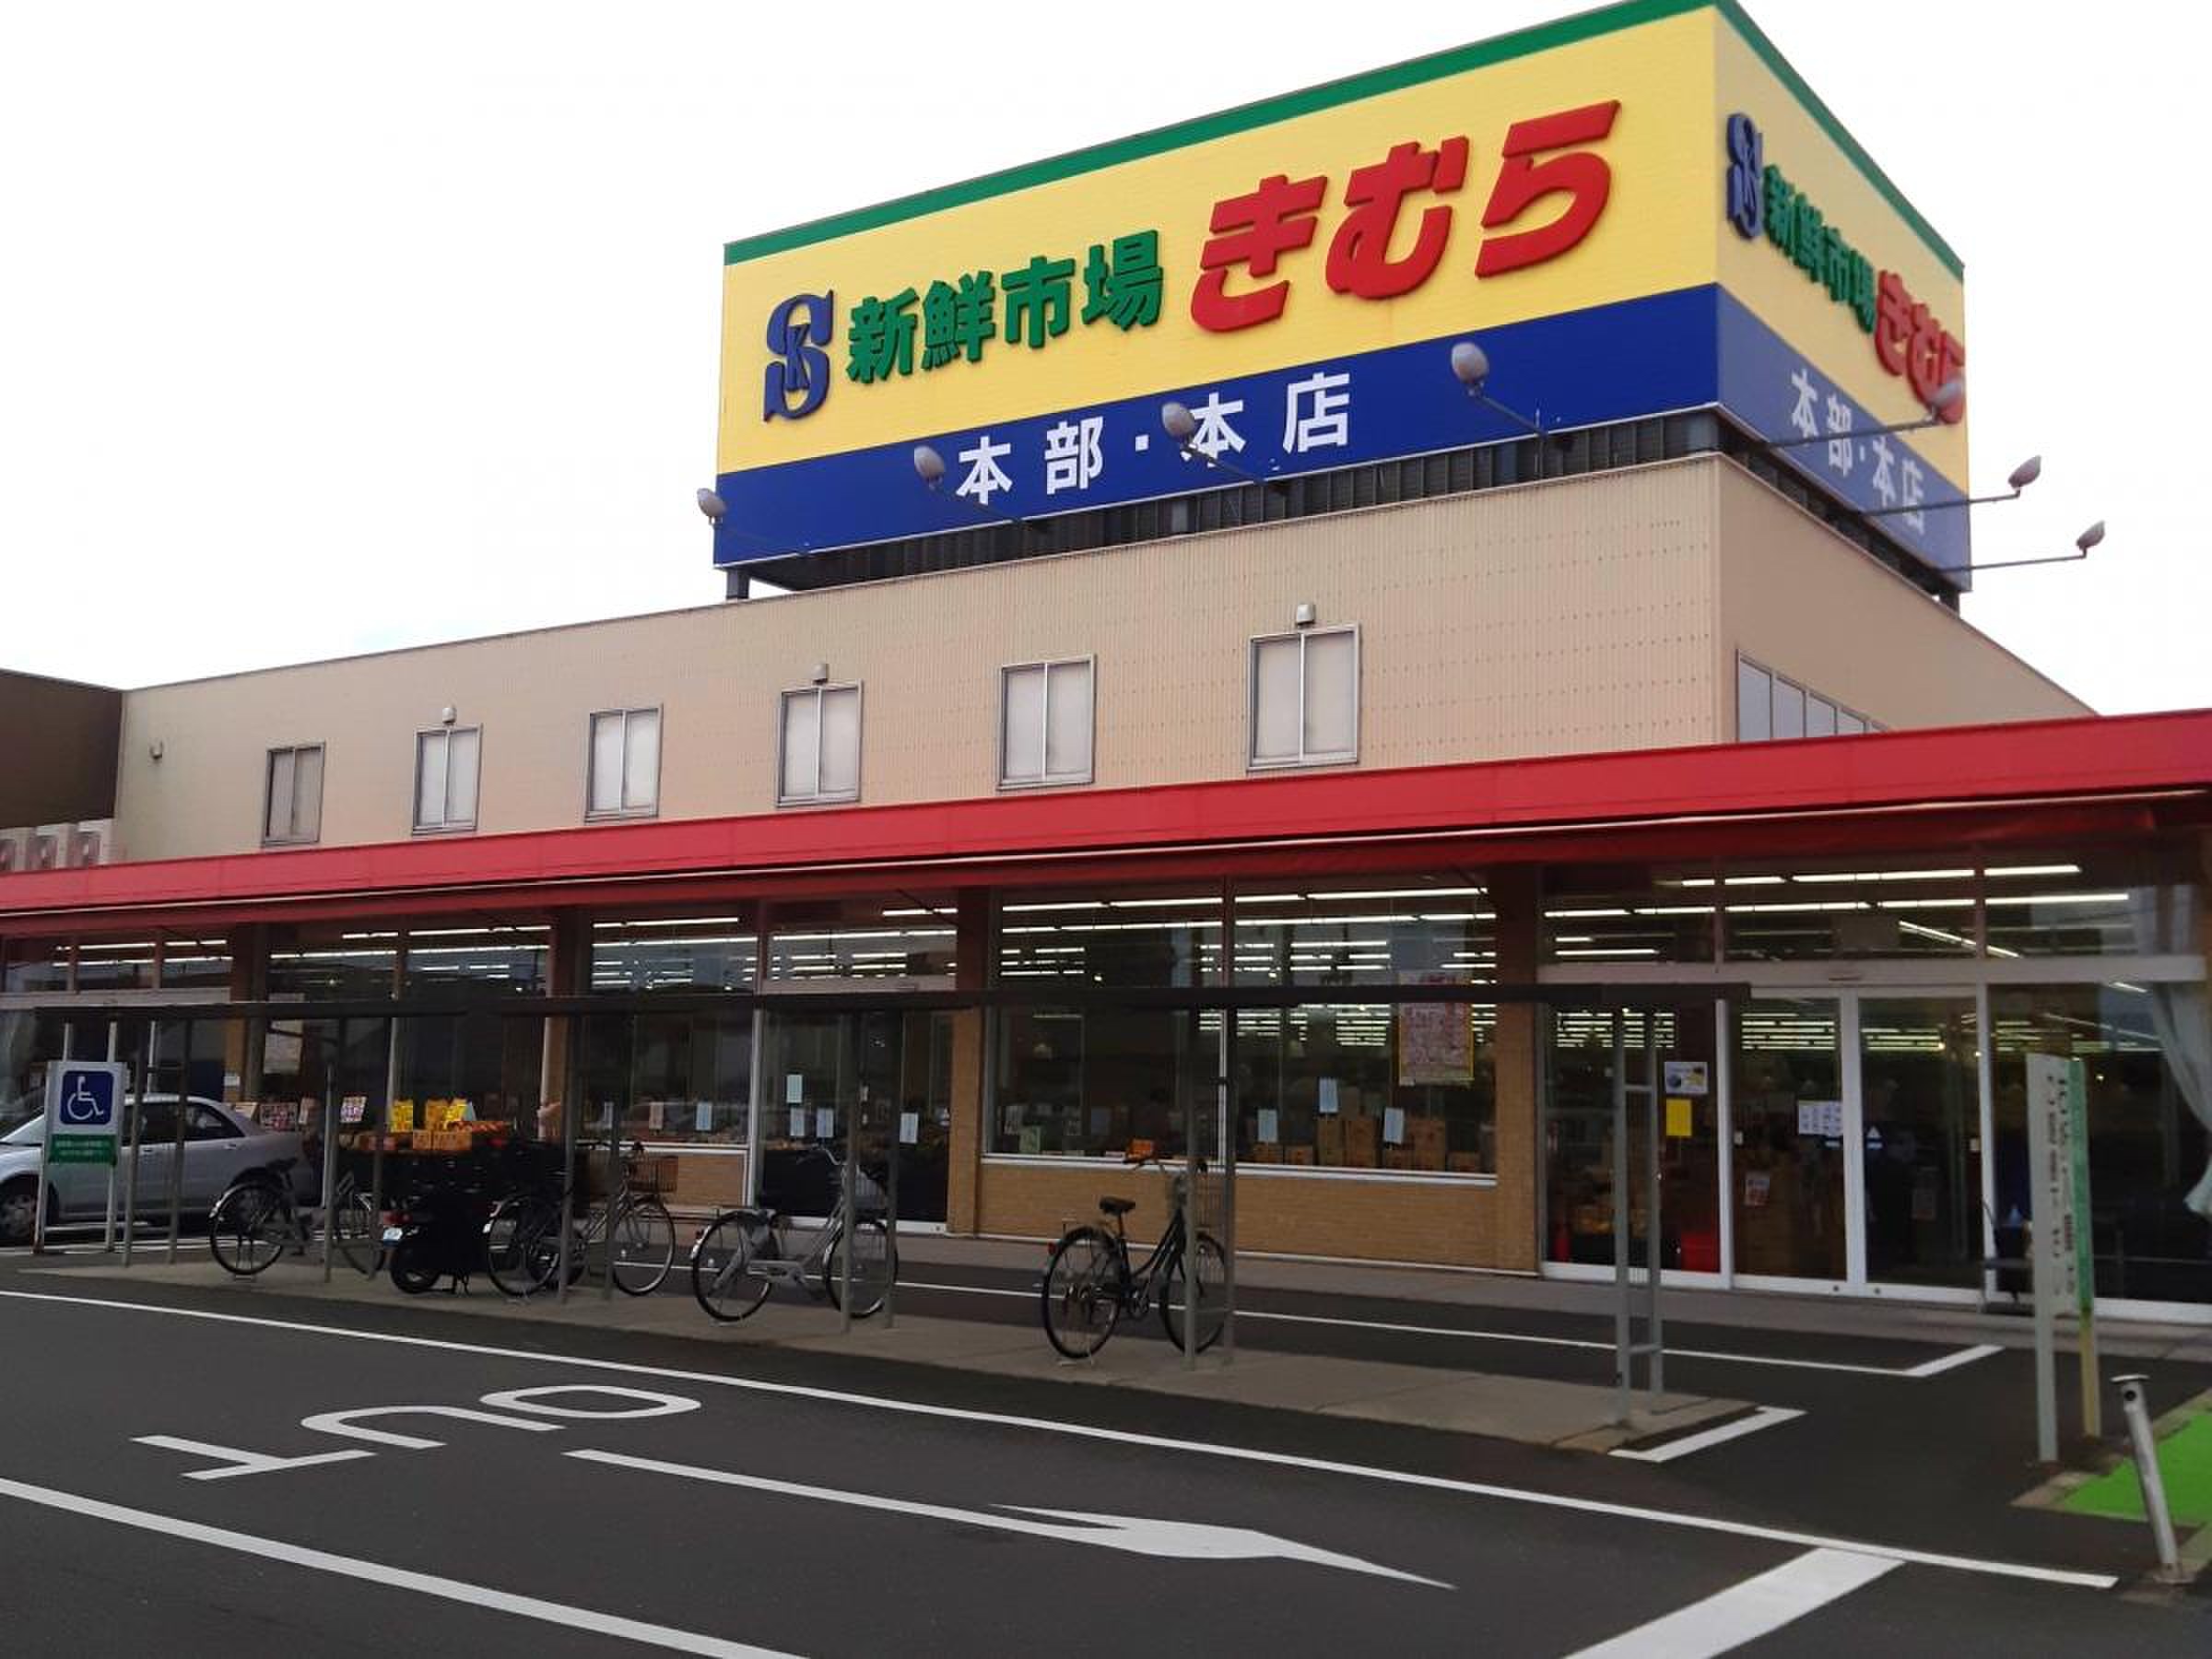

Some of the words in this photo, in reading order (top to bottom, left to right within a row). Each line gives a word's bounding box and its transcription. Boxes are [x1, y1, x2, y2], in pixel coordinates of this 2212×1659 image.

[845, 229, 1164, 385] 新鮮市場
[1191, 100, 1622, 333] きむら
